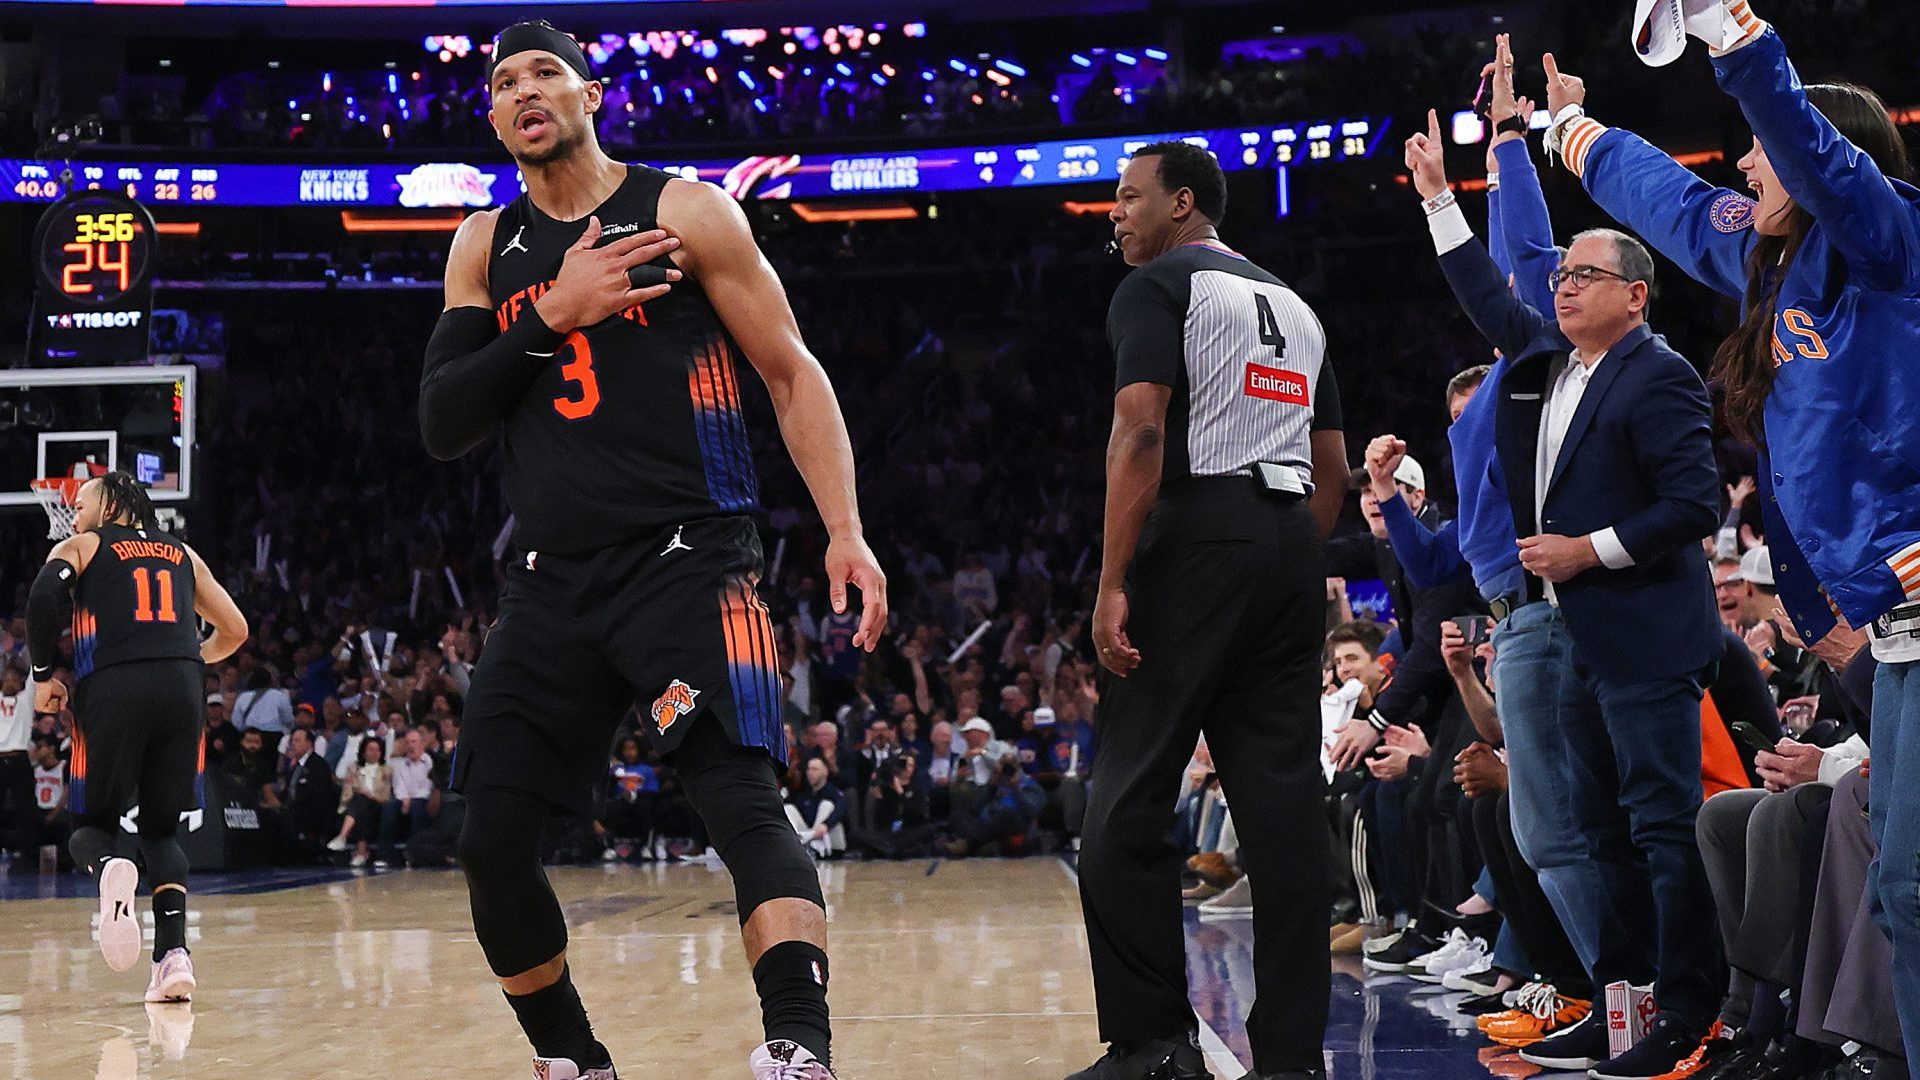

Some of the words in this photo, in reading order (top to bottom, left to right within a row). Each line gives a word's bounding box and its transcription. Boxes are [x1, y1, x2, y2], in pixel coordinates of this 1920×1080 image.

[301, 169, 332, 181] NEW
[332, 169, 369, 181] YORK
[831, 156, 919, 172] CLEVELAND
[15, 181, 58, 198] 40.0
[155, 184, 180, 200] 22
[191, 184, 216, 200] 26
[300, 180, 369, 201] KNICKS
[830, 168, 919, 191] CAVALIERS
[75, 213, 134, 243] 3:56
[63, 242, 129, 293] 24
[72, 311, 141, 328] TISSOT
[1254, 292, 1286, 359] 4
[553, 329, 601, 420] 3
[1251, 371, 1303, 397] Emirates
[111, 540, 184, 566] BRUNSON
[133, 567, 177, 622] 11
